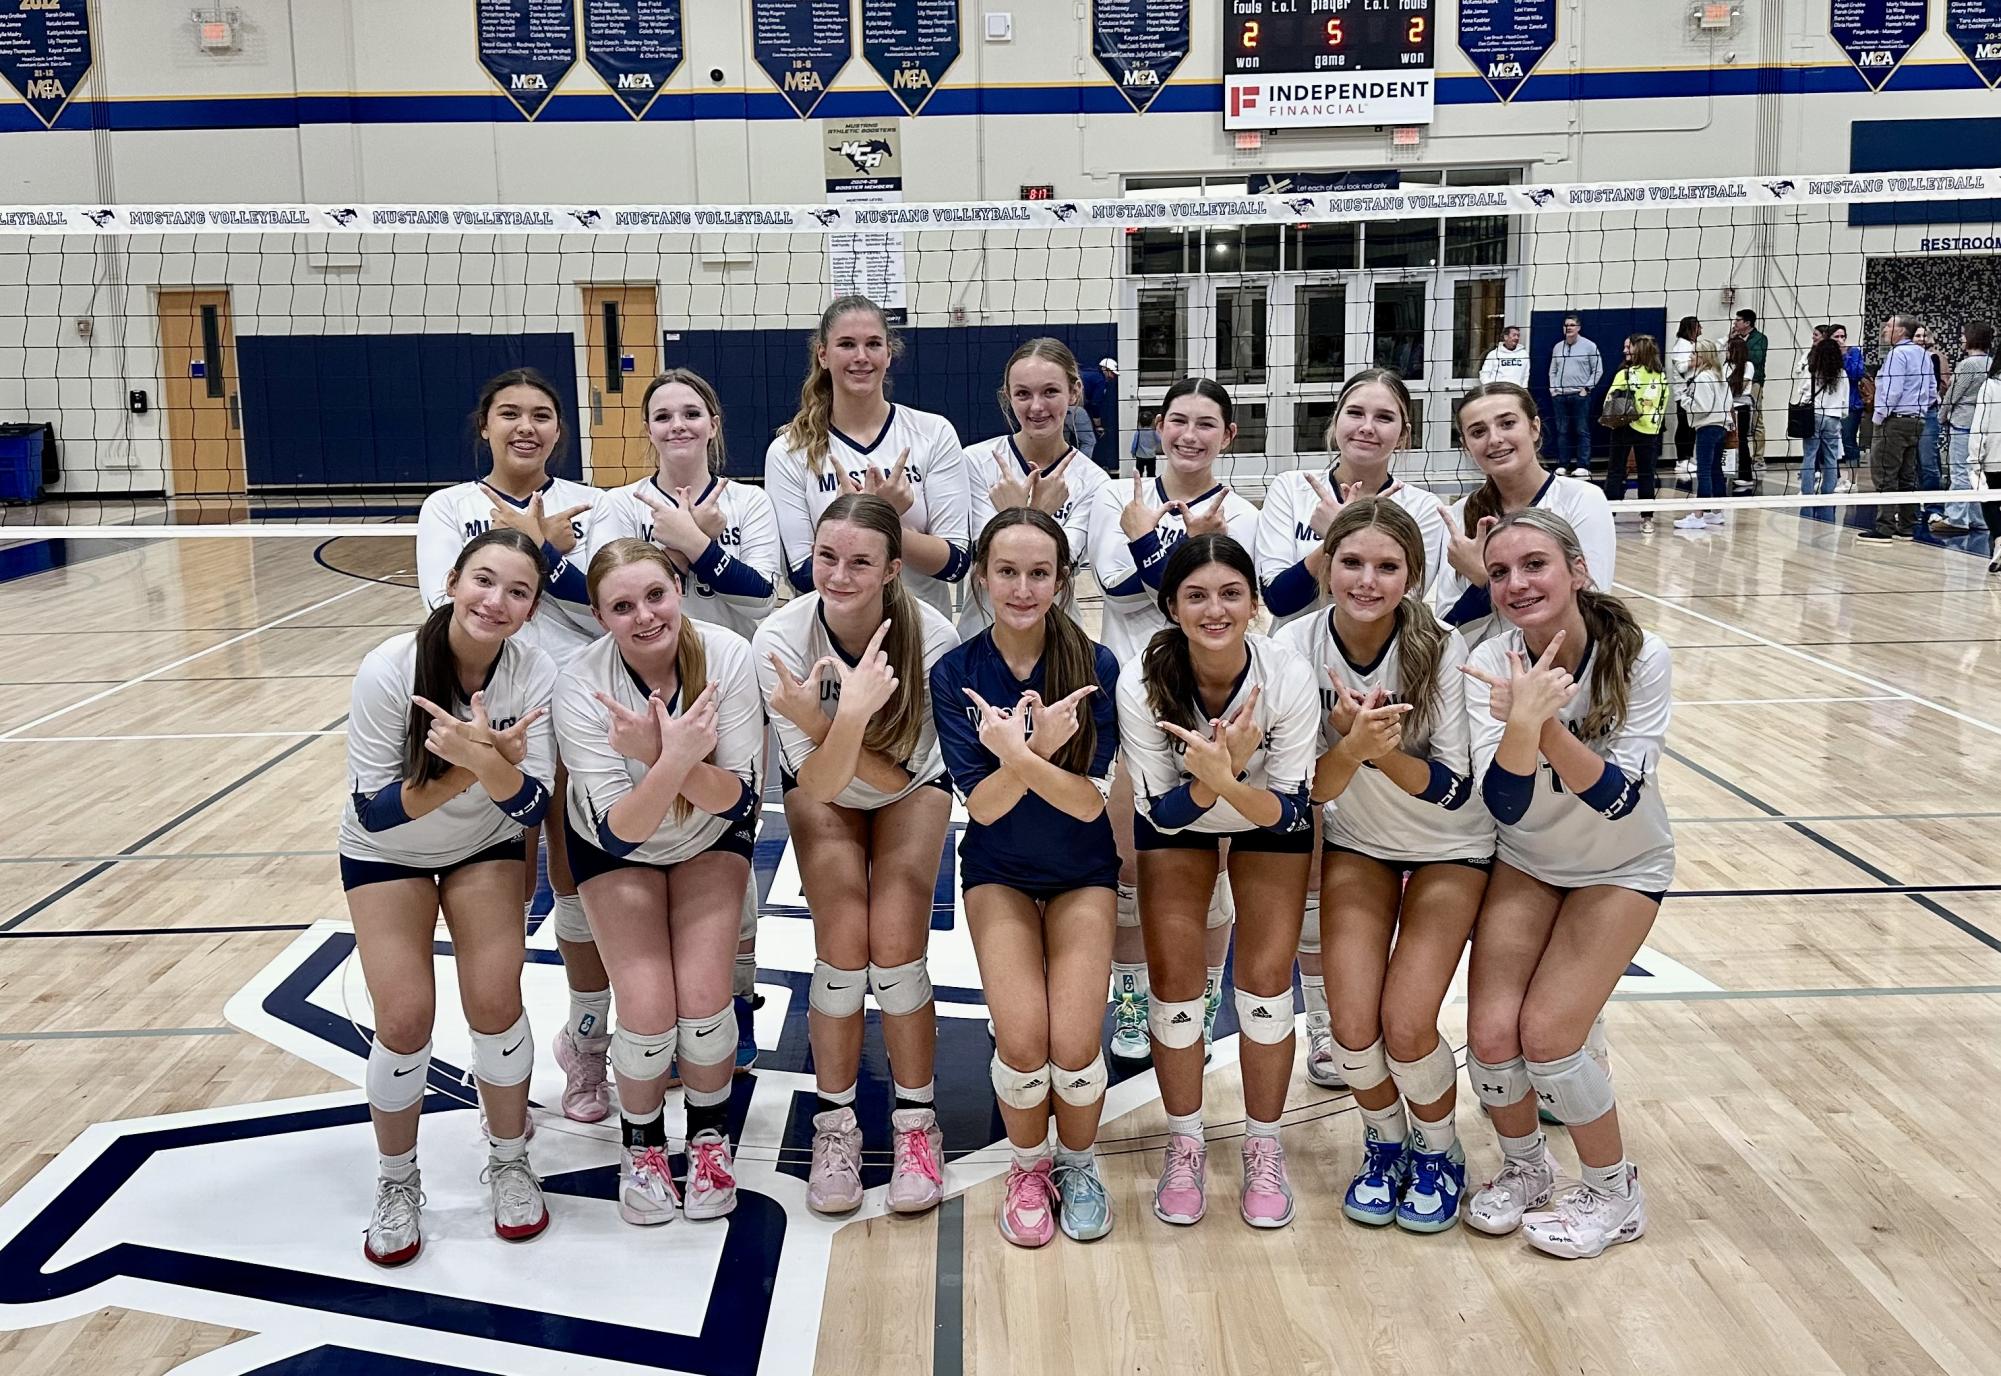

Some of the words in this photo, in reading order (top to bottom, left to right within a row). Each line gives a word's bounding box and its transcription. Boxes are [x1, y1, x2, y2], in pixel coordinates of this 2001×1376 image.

[1234, 0, 1262, 14] fouls
[1311, 0, 1350, 13] player
[1243, 22, 1259, 47] 2
[1327, 19, 1343, 45] 5
[1409, 17, 1425, 43] 2
[1236, 57, 1259, 68] won
[1315, 55, 1345, 69] game
[1401, 52, 1424, 64] won
[1269, 81, 1429, 102] INDEPENDENT
[1269, 104, 1366, 116] FINANCIAL
[840, 141, 882, 167] MCA
[1809, 179, 1884, 194] MUSTANG
[1888, 176, 1985, 191] VOLLEYBALL
[1569, 188, 1645, 203] MUSTANG
[1649, 184, 1747, 200] VOLLEYBALL
[1330, 197, 1404, 212] MUSTANG
[1407, 192, 1507, 209] VOLLEYBALL
[130, 211, 206, 225] MUSTANG
[209, 211, 309, 225] VOLLEYBALL
[373, 211, 449, 224] MUSTANG
[453, 211, 553, 225] VOLLEYBALL
[616, 212, 691, 225] MUSTANG
[695, 211, 793, 224] VOLLEYBALL
[855, 209, 929, 223] MUSTANG
[933, 207, 1030, 222] VOLLEYBALL
[1092, 205, 1165, 219] MUSTANG
[1170, 202, 1267, 217] VOLLEYBALL
